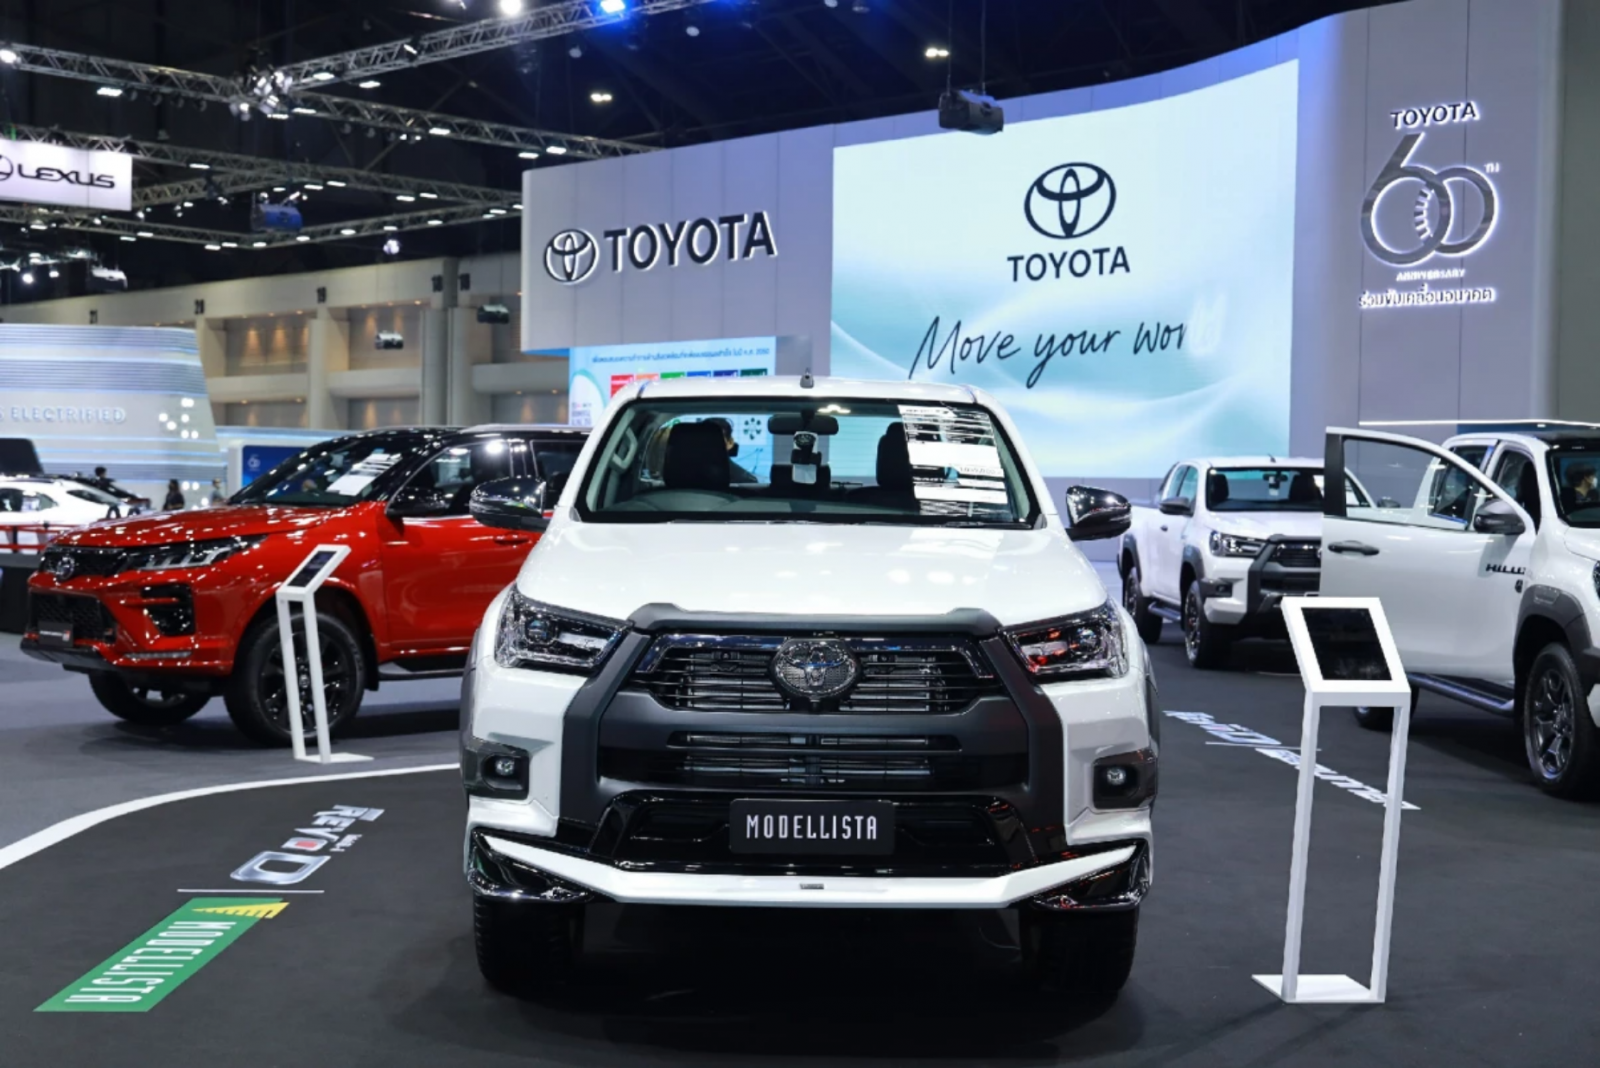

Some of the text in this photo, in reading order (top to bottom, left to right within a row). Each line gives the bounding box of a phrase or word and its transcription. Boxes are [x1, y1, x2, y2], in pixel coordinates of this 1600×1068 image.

[1390, 101, 1480, 130] TOYOTA
[17, 163, 115, 188] LEXUS
[603, 211, 778, 273] TOYOTA
[1007, 246, 1131, 282] TOYOTA
[908, 315, 1021, 380] Move
[1026, 330, 1121, 389] your
[10, 404, 128, 425] ELECTRIFIED
[746, 814, 878, 840] MODELLISTA
[64, 921, 238, 1003] MODELLISTA
